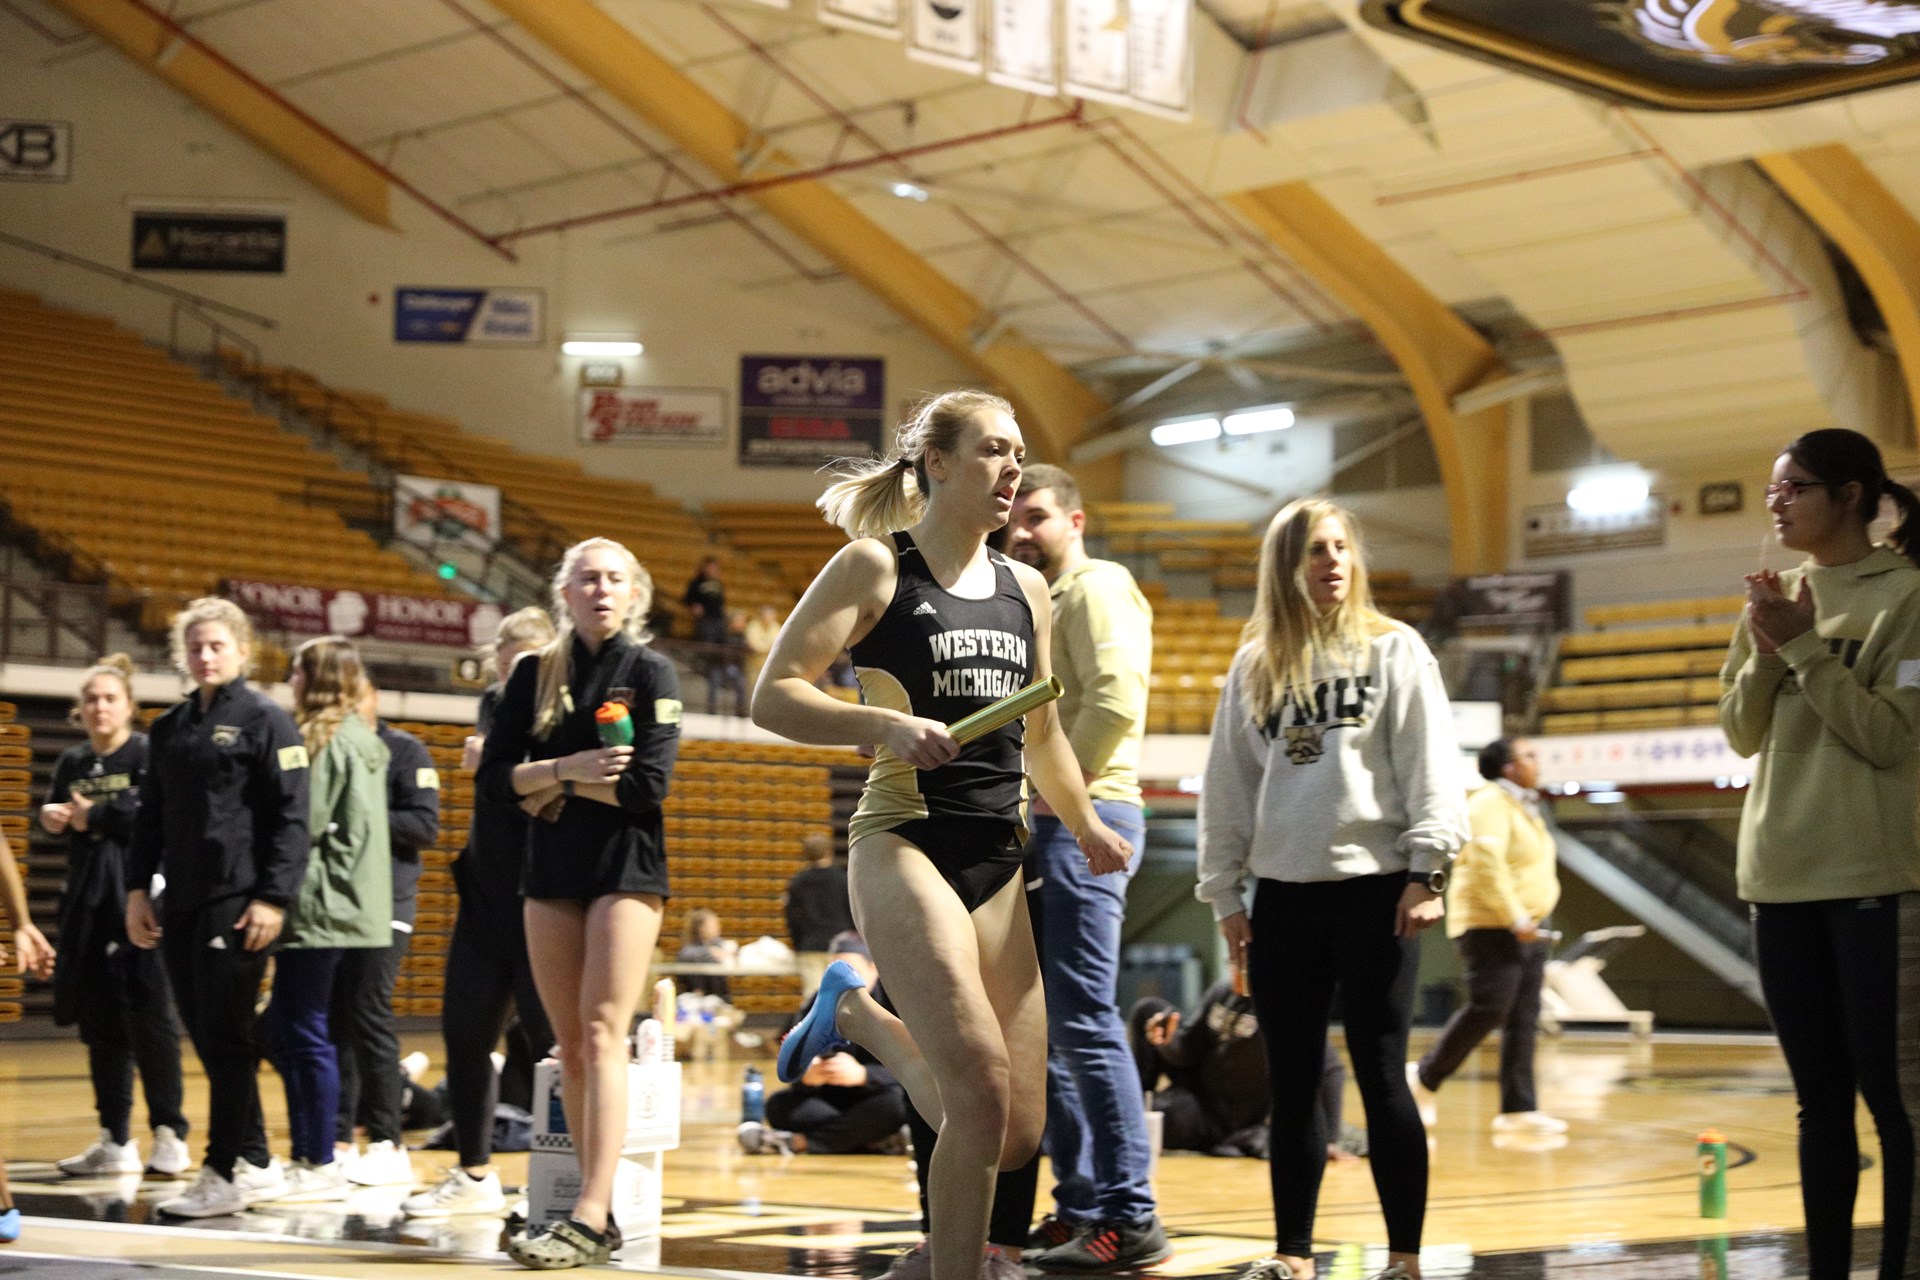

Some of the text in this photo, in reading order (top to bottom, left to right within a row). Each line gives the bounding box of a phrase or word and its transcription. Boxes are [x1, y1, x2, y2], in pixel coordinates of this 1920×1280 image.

[757, 361, 866, 395] advia
[377, 595, 463, 626] HONOR
[929, 629, 1027, 669] WESTERN
[932, 668, 1025, 698] MICHIGAN
